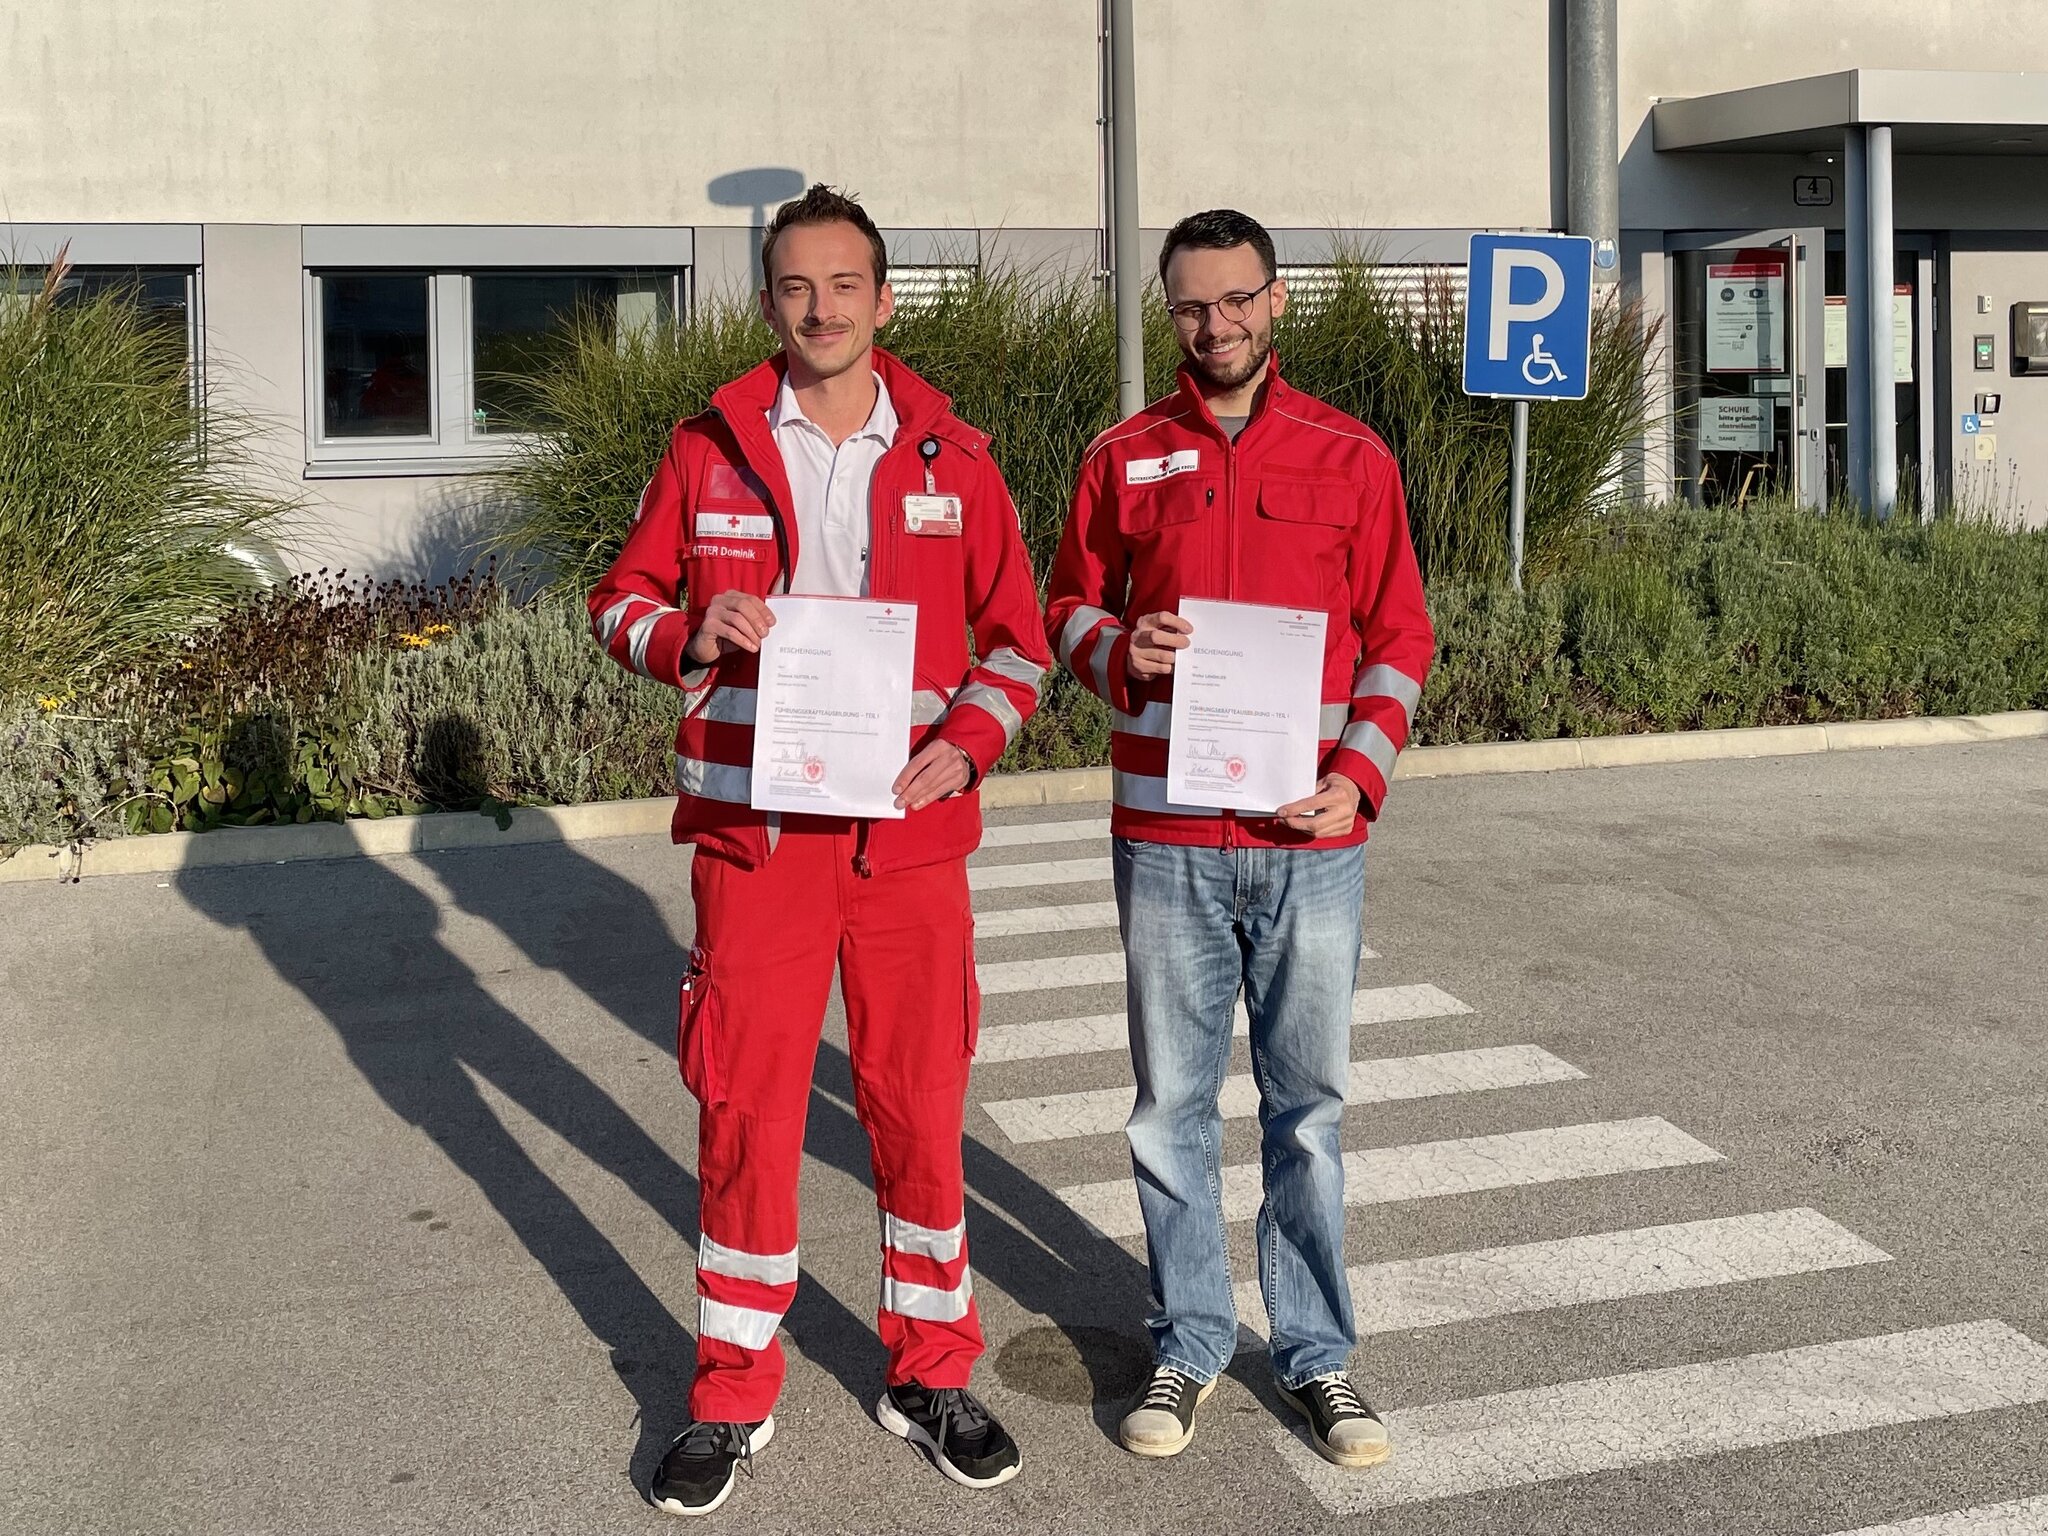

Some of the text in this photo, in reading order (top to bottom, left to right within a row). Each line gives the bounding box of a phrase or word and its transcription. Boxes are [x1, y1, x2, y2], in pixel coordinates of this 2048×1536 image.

[1808, 177, 1818, 194] 4
[1489, 248, 1565, 361] P
[1718, 405, 1750, 414] SCHUHE
[720, 546, 756, 559] Dominik
